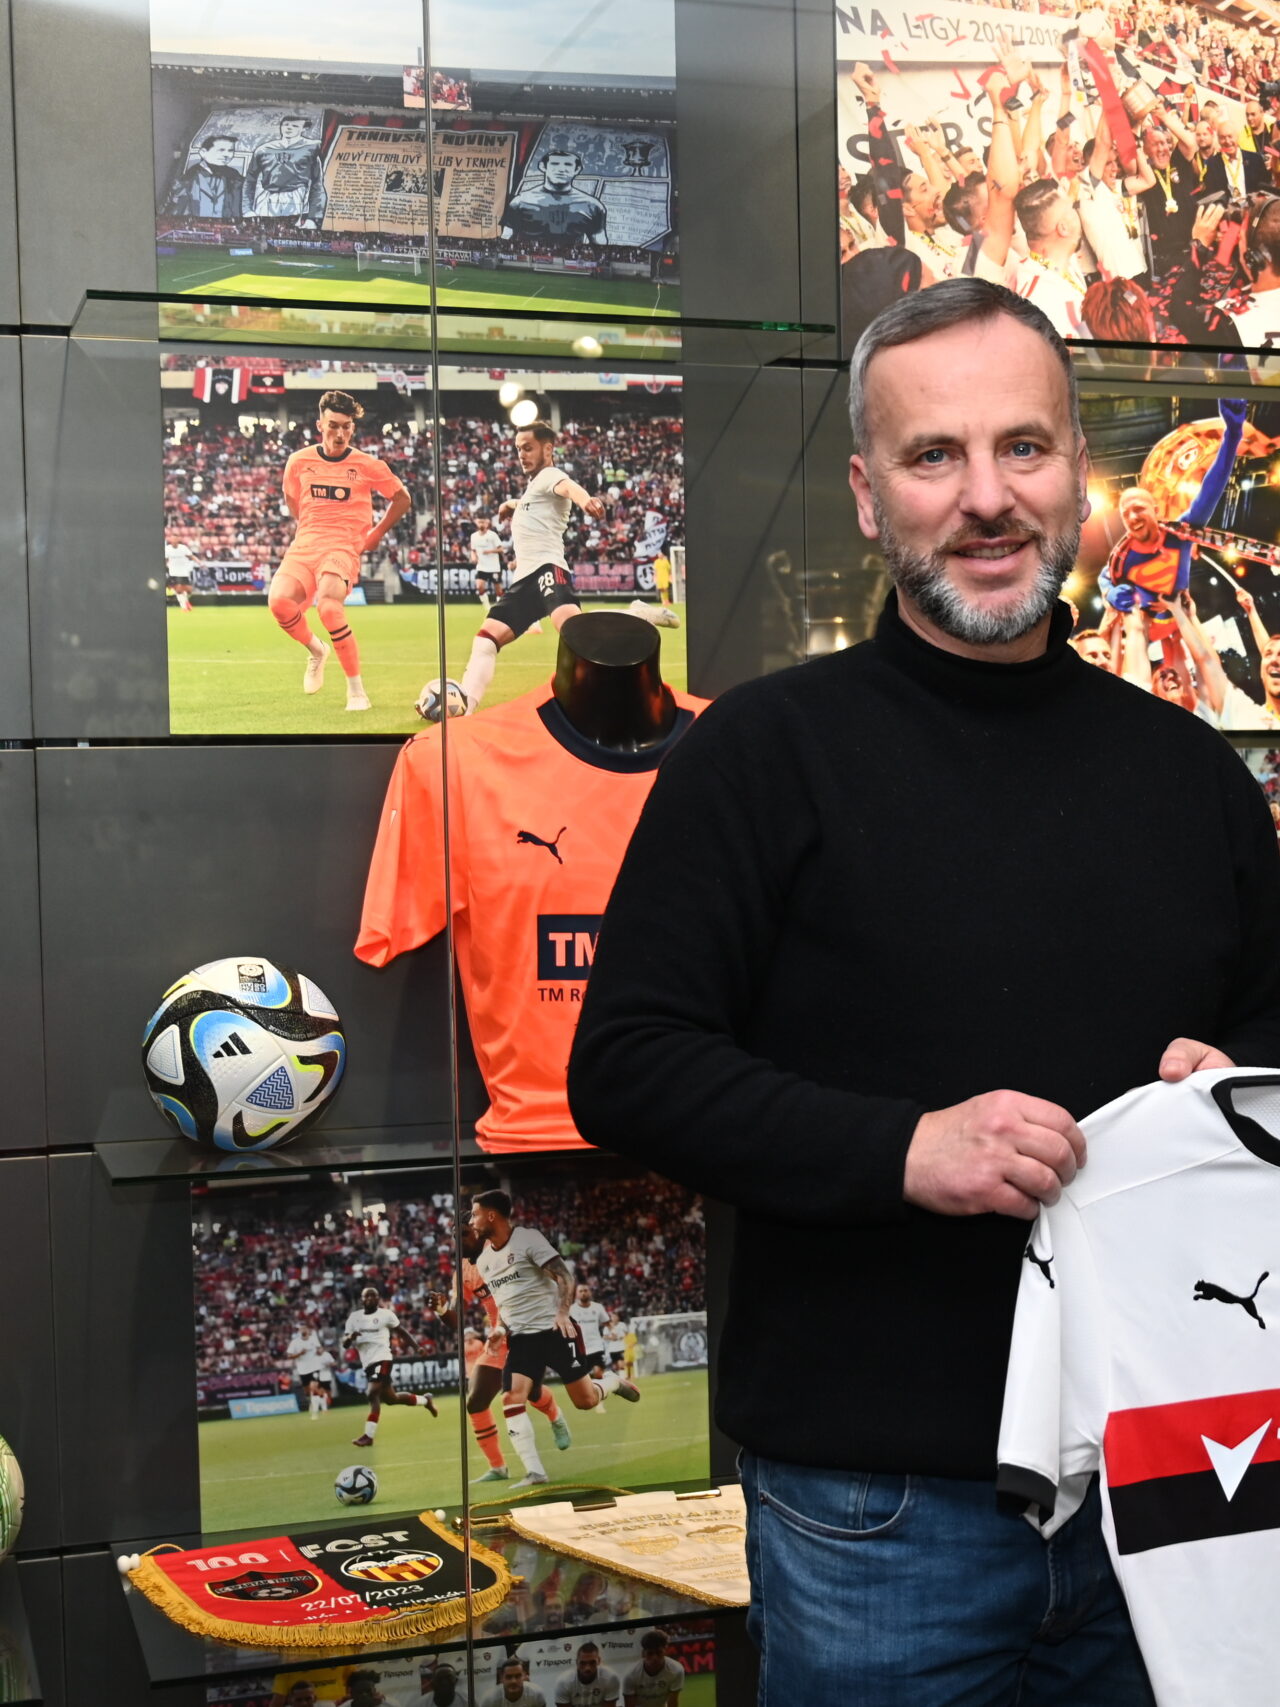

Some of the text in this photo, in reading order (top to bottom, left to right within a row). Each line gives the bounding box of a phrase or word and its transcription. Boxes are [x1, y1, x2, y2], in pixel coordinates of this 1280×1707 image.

[537, 571, 555, 592] 28
[548, 932, 599, 967] TM
[537, 987, 564, 1002] TM
[490, 1271, 521, 1289] Tipsport
[567, 1342, 577, 1359] 7
[186, 1530, 409, 1572] 100 FCST
[300, 1584, 425, 1612] 22/07/2023
